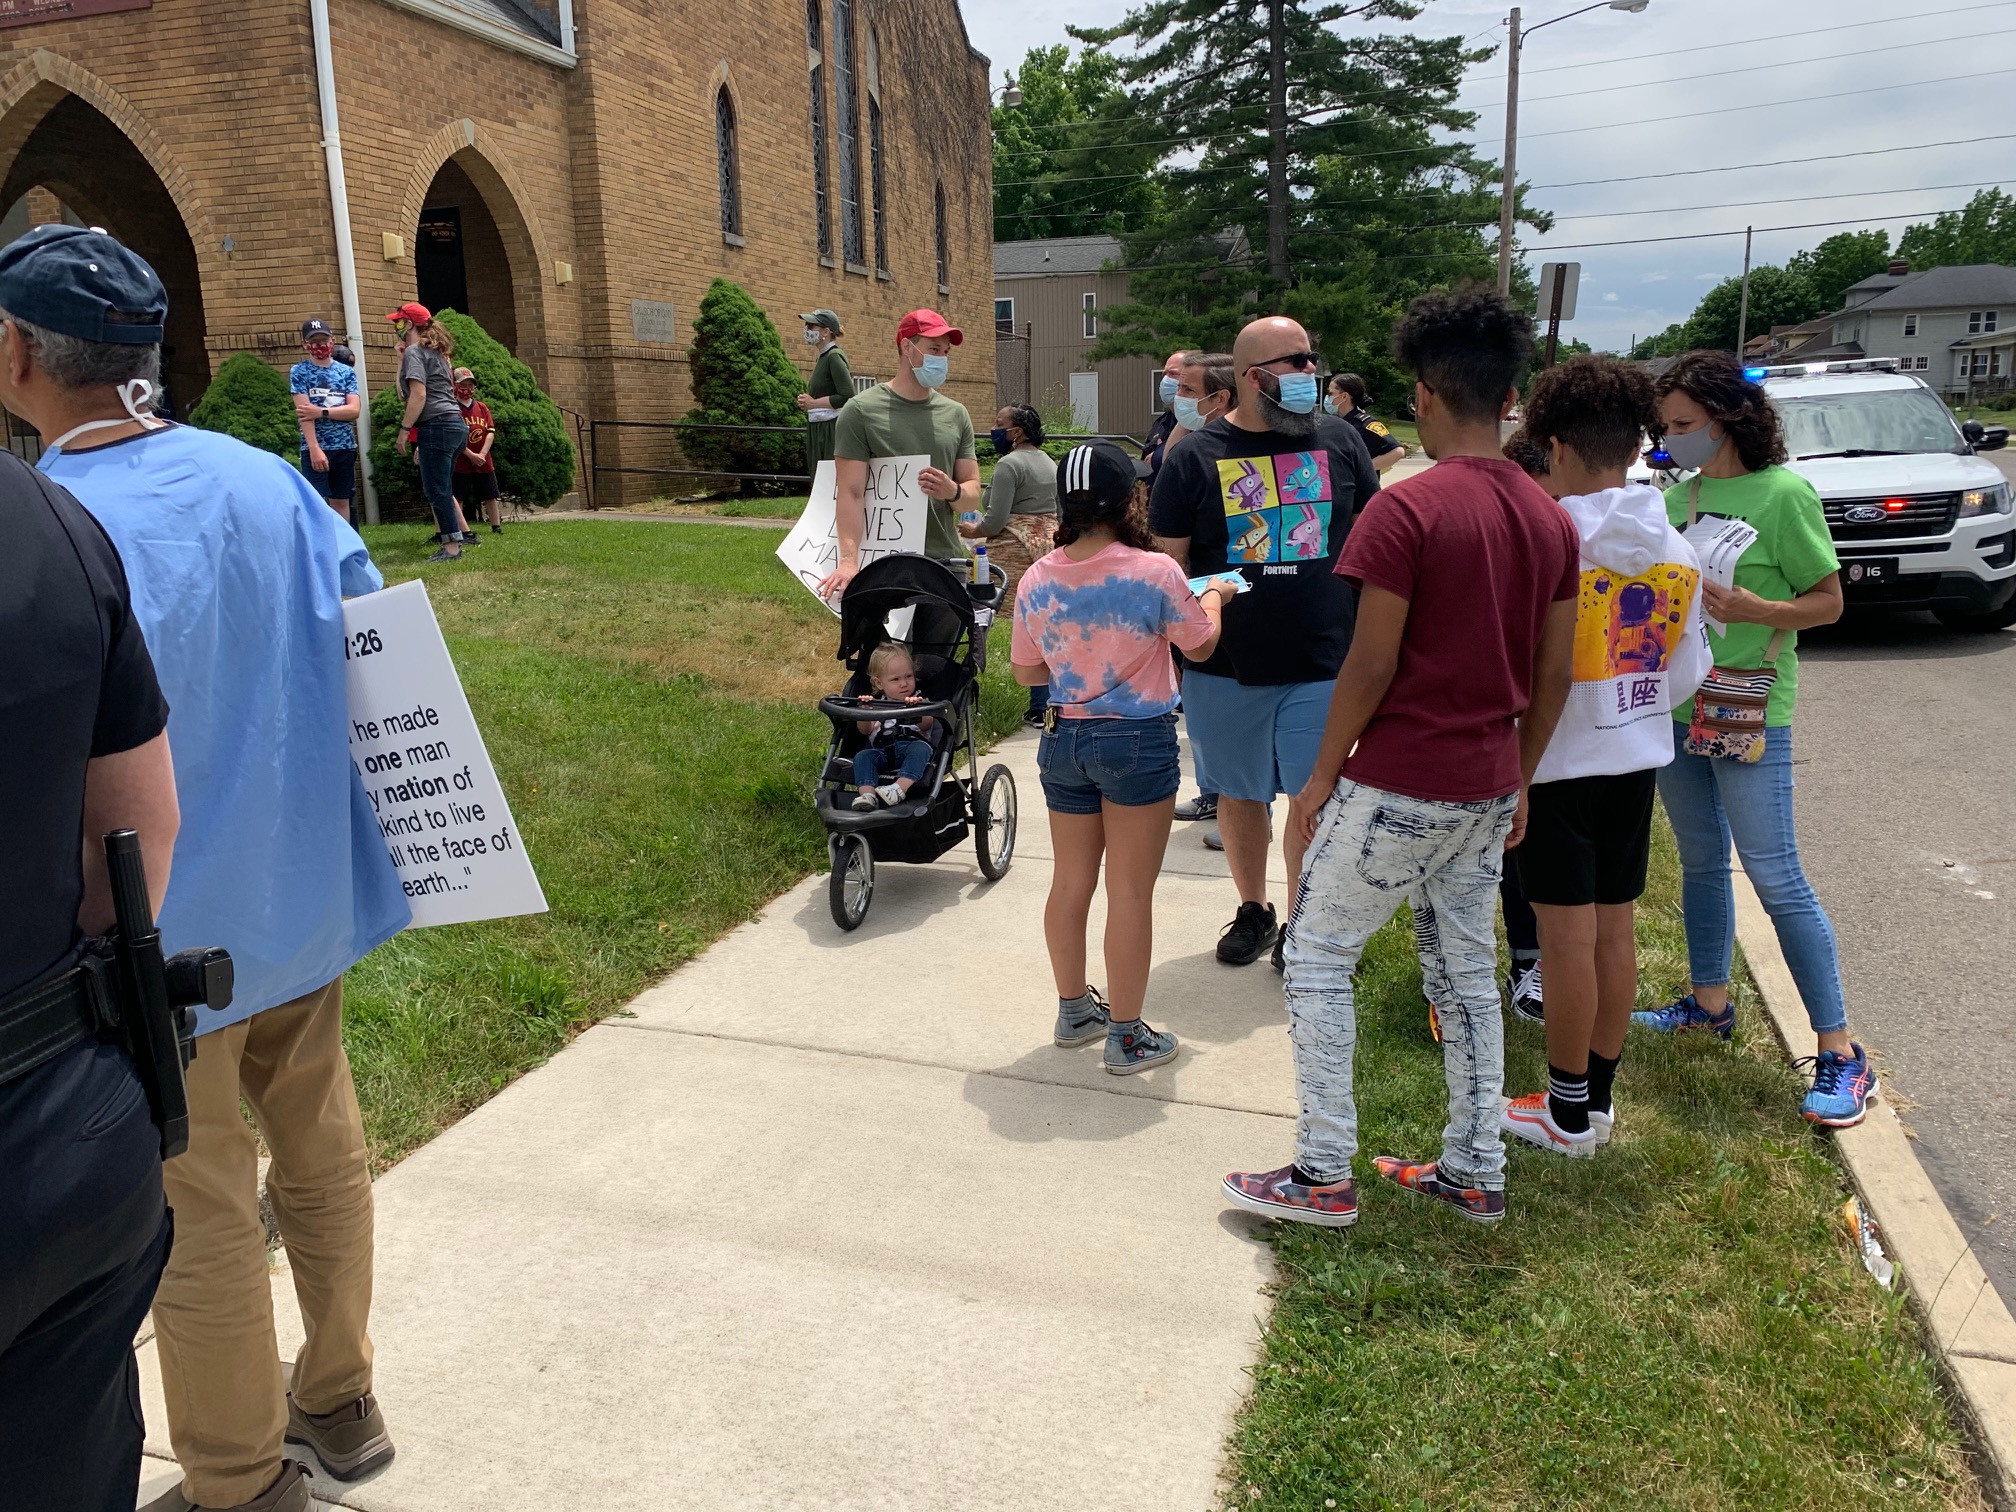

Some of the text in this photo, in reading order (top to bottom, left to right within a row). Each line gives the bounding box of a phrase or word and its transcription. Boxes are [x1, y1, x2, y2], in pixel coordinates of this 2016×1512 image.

[2, 1, 15, 10] PM
[833, 463, 909, 500] ACK
[828, 507, 904, 541] LVES
[1854, 508, 1878, 519] Ford
[1262, 565, 1298, 576] FORTNITE
[1866, 567, 1881, 576] 16
[353, 705, 439, 742] he made
[365, 752, 403, 774] one
[406, 740, 451, 766] man
[384, 774, 450, 804] nation
[453, 766, 474, 791] of
[378, 803, 486, 838] kind to live
[407, 843, 440, 864] the
[442, 835, 487, 860] face
[491, 827, 513, 851] of
